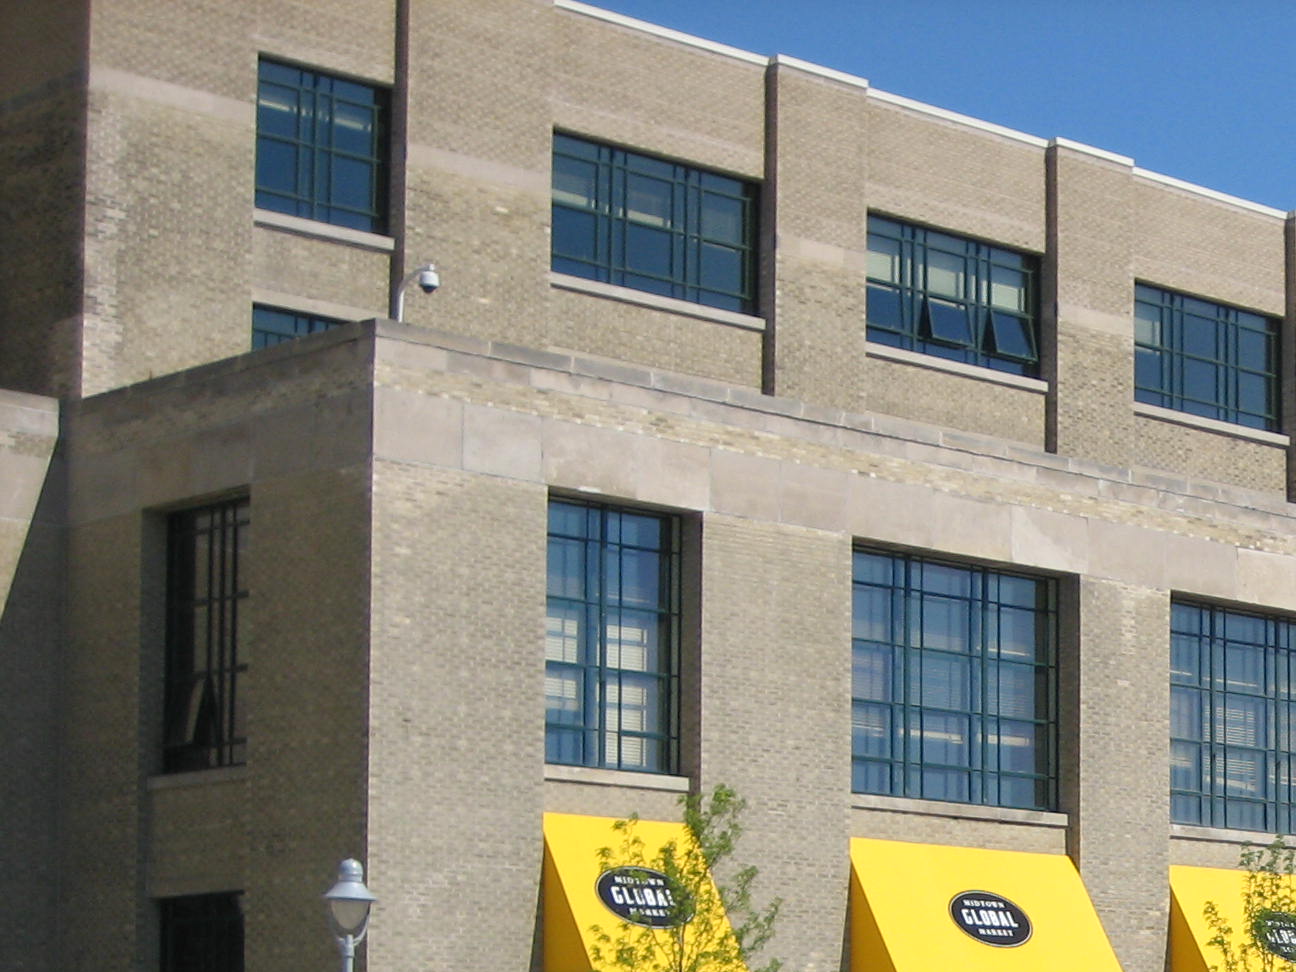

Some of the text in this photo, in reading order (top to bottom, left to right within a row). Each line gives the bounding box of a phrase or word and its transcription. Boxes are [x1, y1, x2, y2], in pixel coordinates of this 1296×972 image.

[613, 875, 665, 886] MIDTWN
[962, 899, 1006, 909] MIDTOWN
[961, 908, 1019, 928] GLOBAL
[978, 928, 1014, 937] MARKET
